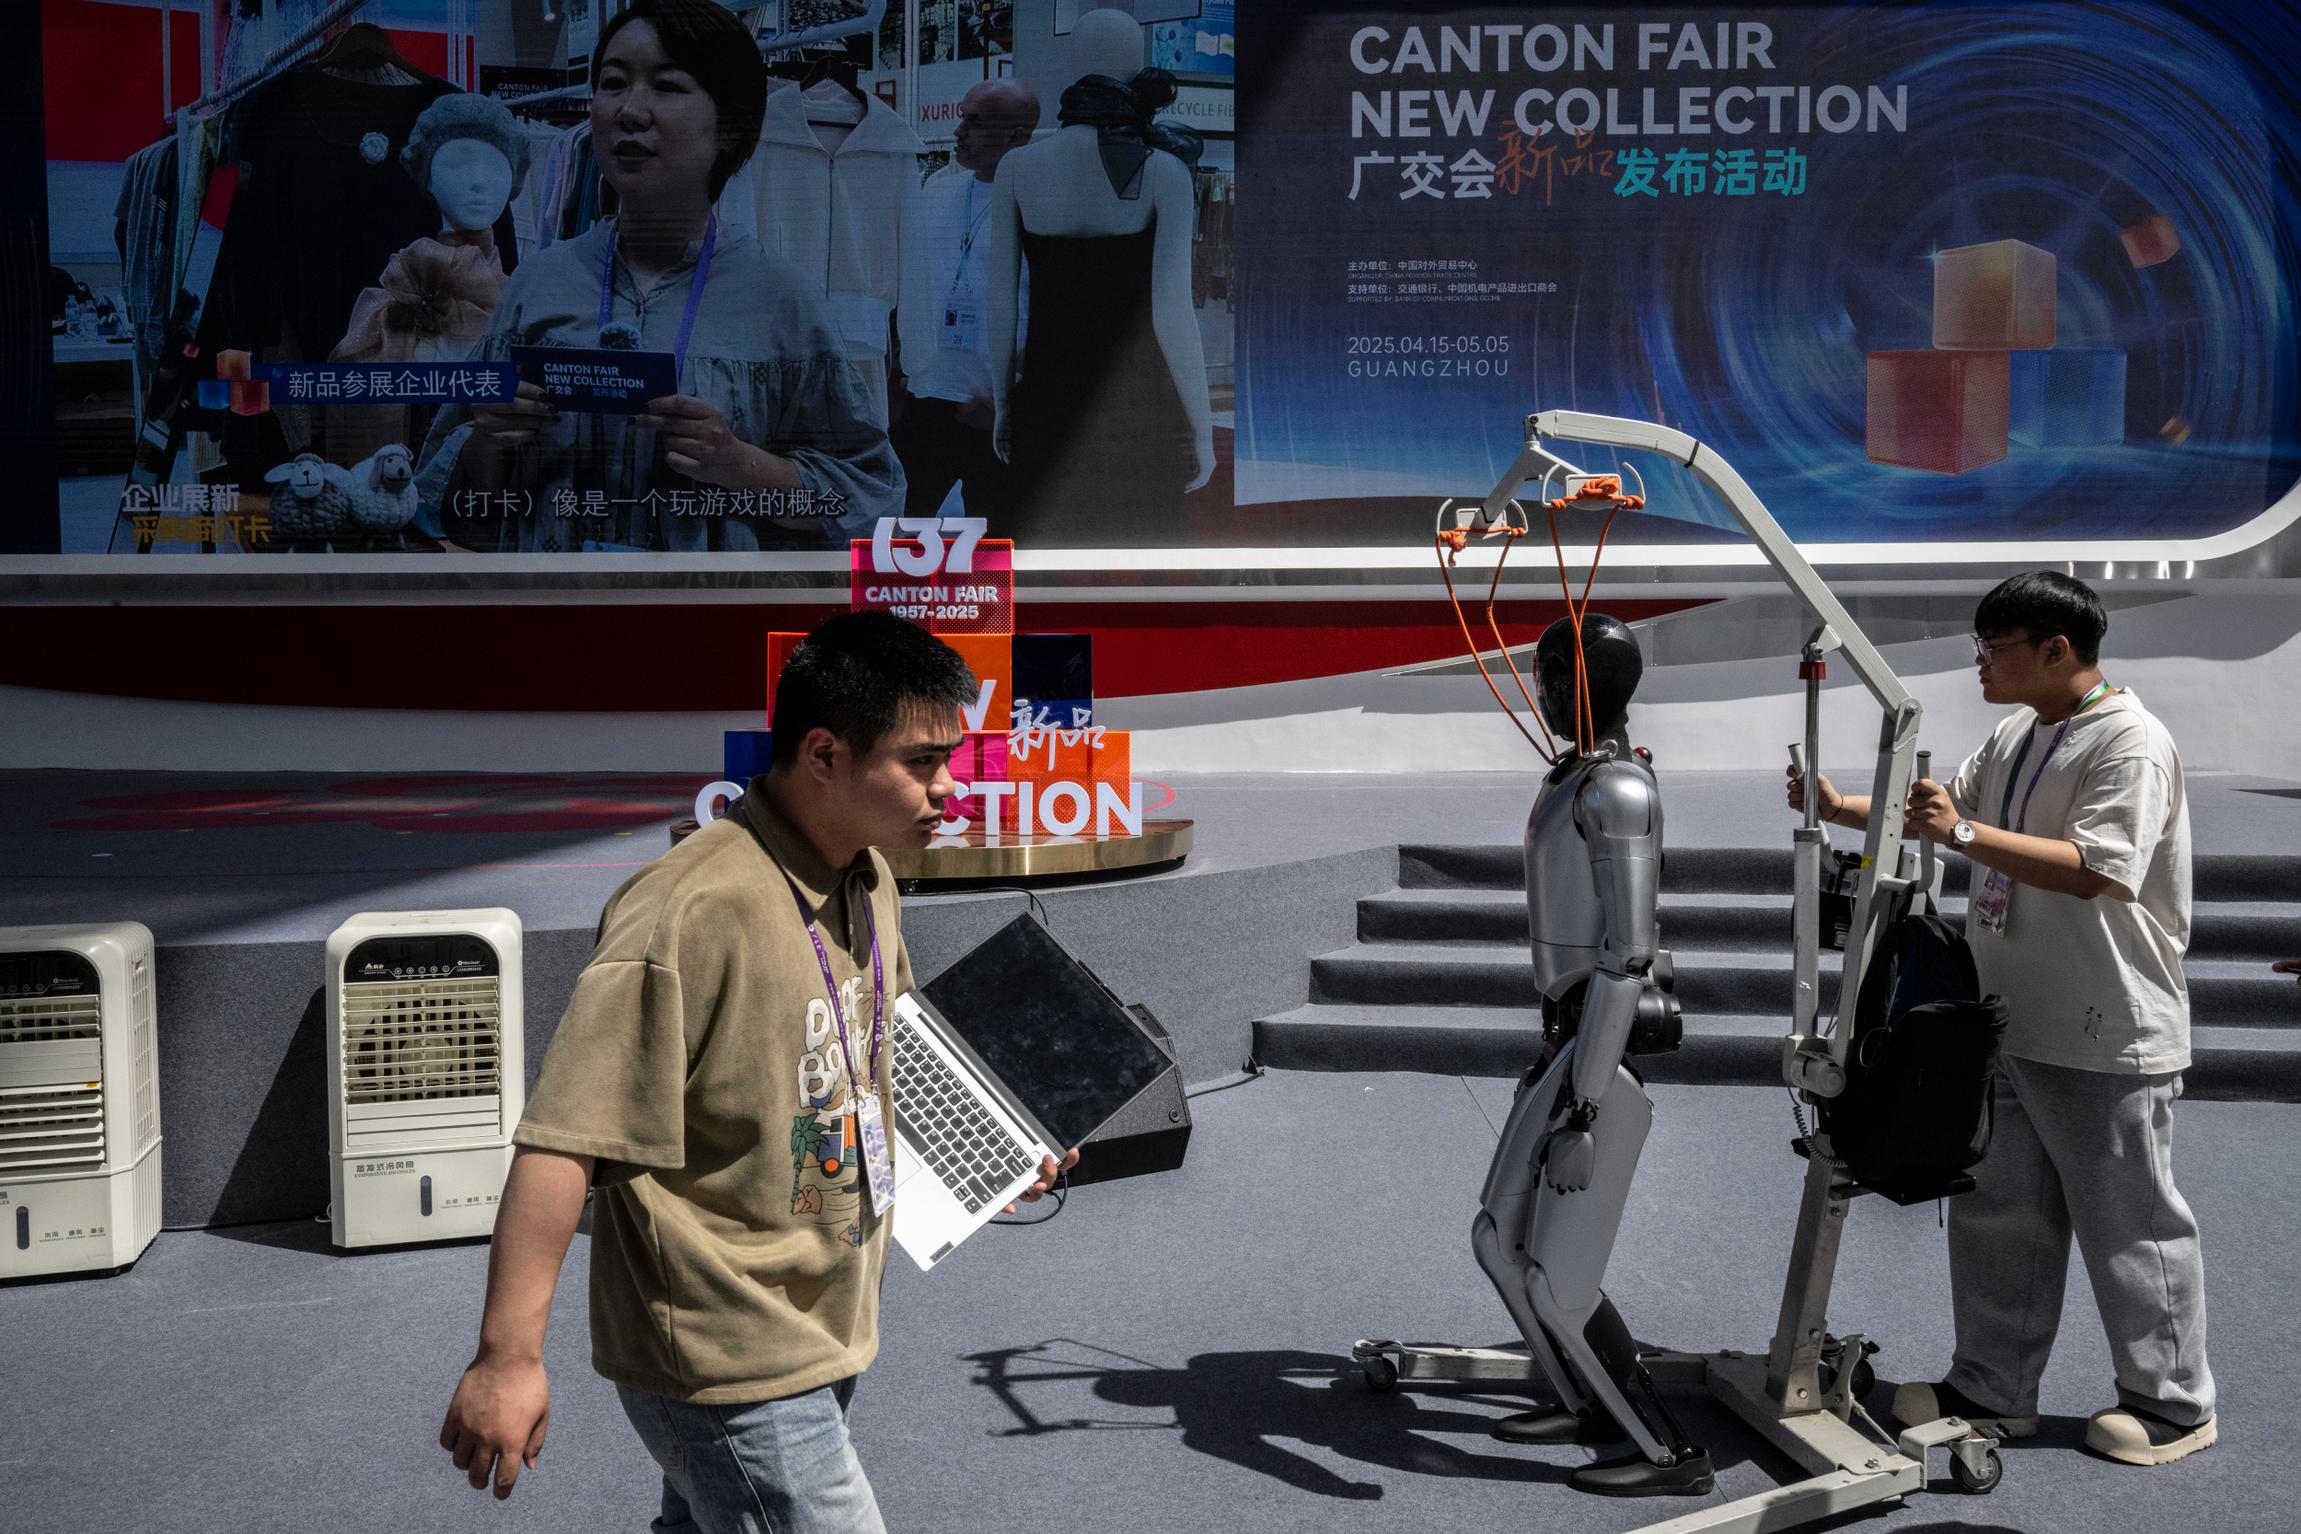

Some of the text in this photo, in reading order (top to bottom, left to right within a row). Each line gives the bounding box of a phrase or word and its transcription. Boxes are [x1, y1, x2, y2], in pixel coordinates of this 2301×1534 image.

[1350, 22, 1775, 74] CANTON FAIR
[1352, 86, 1907, 138] NEW COLLECTION
[1347, 335, 1509, 354] 2025.04.15-05.05
[543, 362, 620, 377] CANTON FAIR
[545, 374, 645, 389] NEW COLLECTION
[1348, 359, 1508, 377] GUANGZHOU
[288, 369, 501, 399] 新品参展企业代表
[121, 482, 240, 513] 企业展新
[452, 487, 846, 519] （打卡）像是一个玩游戏的概念
[872, 517, 988, 577] 137
[866, 586, 999, 603] CANTON FAIR
[890, 605, 980, 620] 1957-2025
[1008, 699, 1106, 772] 新品
[695, 780, 1142, 837] CCTION
